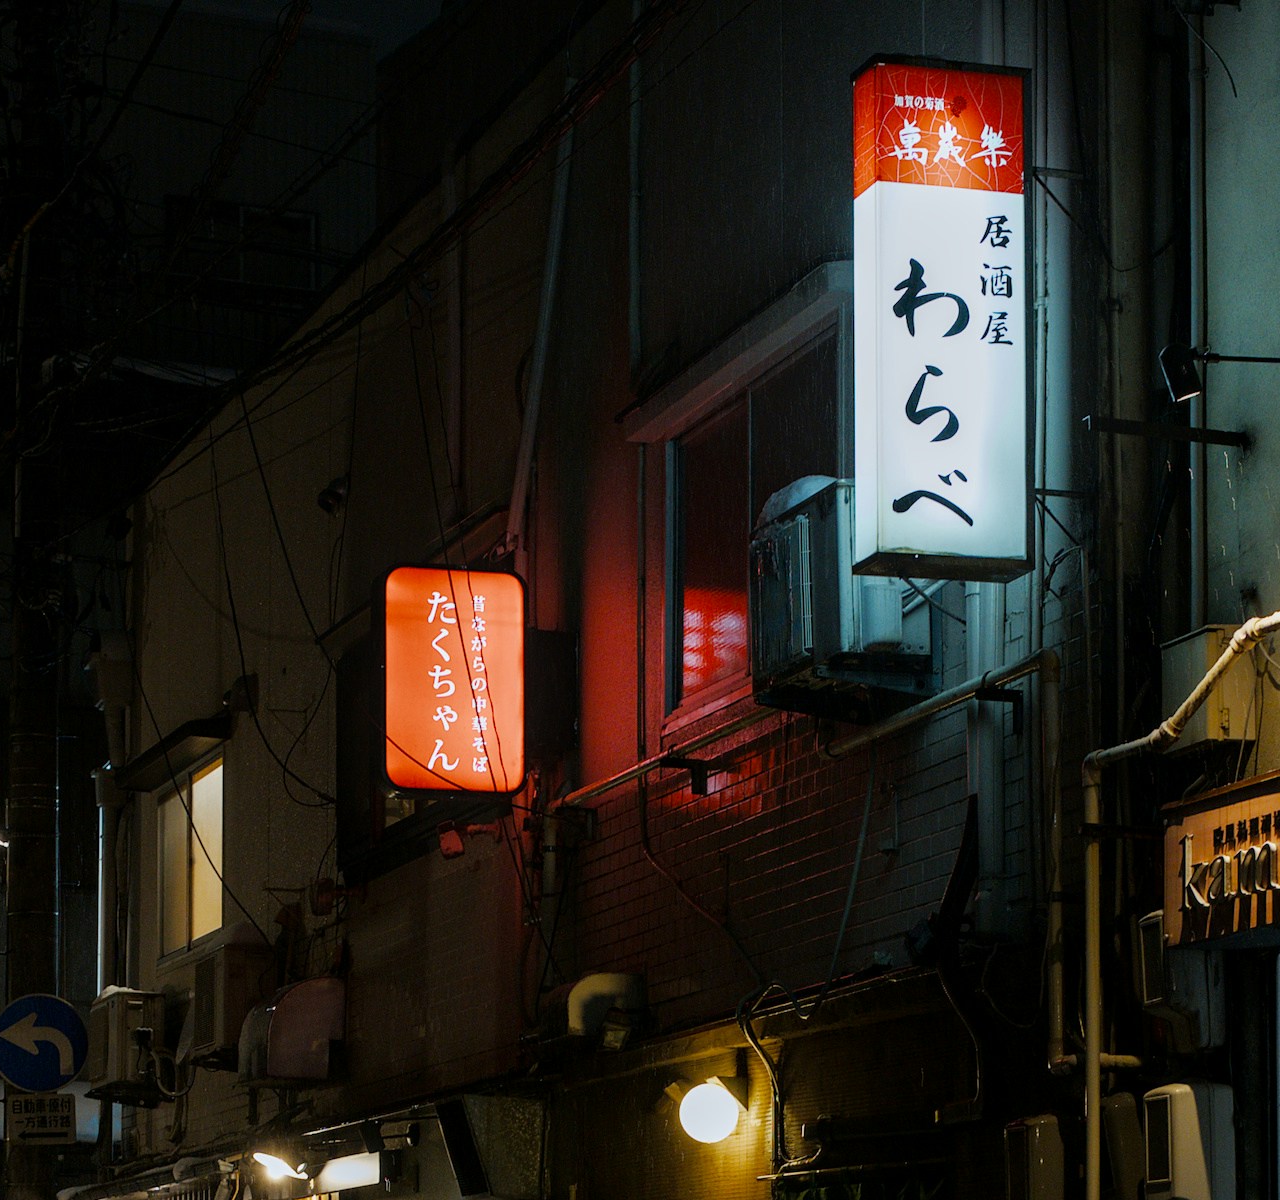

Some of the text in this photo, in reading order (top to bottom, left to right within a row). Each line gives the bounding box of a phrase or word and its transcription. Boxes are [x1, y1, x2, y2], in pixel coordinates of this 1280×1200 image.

[979, 215, 1013, 346] 居酒屋
[892, 258, 973, 527] わらべ
[426, 591, 460, 772] たくちゃん
[471, 595, 488, 773] 昔ながらの中華そば
